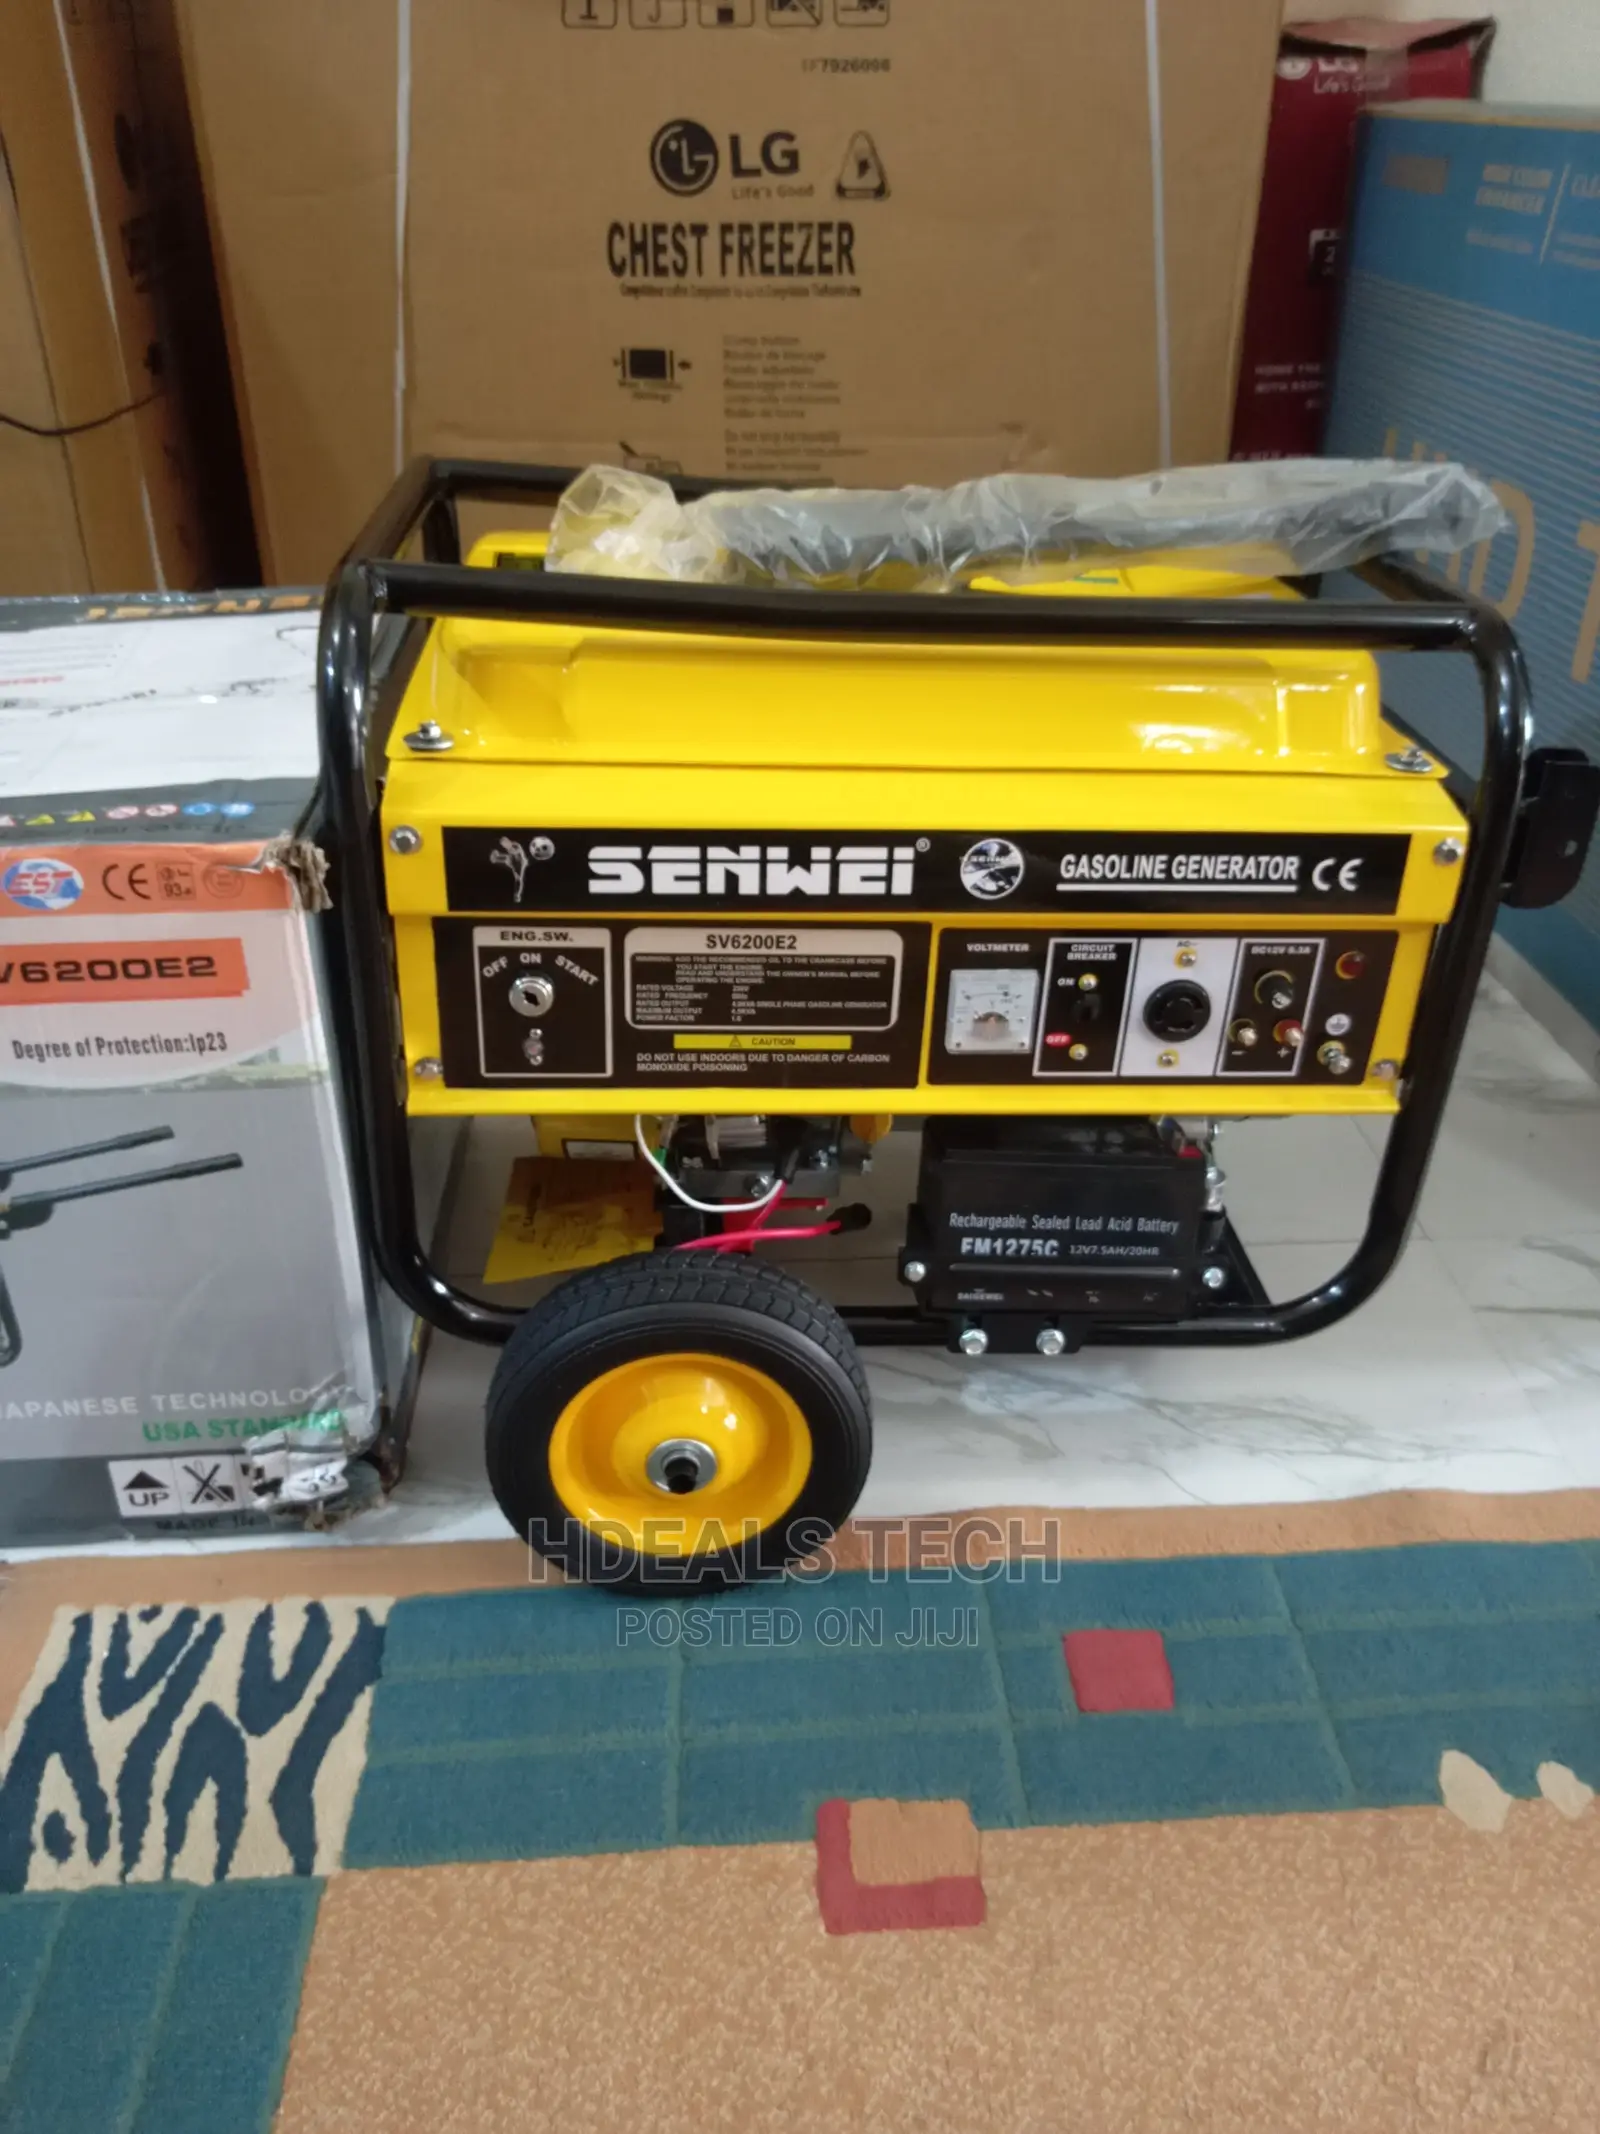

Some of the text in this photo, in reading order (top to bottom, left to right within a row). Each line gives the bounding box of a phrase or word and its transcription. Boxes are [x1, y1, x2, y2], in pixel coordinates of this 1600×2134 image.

[730, 132, 799, 178] LG
[777, 184, 814, 198] Good
[607, 222, 856, 278] CHEST FREEZER
[588, 846, 915, 895] SENWEI
[1060, 854, 1300, 881] GASOLINE GENERATOR
[8, 869, 74, 897] EST
[102, 863, 152, 900] CE
[500, 930, 574, 942] ENG.SW.
[706, 934, 798, 950] SV6200E2
[967, 943, 1030, 952] VOLTMETER
[1067, 952, 1117, 961] BREAKER
[1071, 944, 1115, 952] CIRCUIT
[483, 952, 599, 986] OFF ON START
[1057, 978, 1075, 987] ON
[12, 1039, 71, 1062] Degree
[76, 1037, 91, 1056] of
[751, 1037, 796, 1047] CAUTION
[637, 1053, 890, 1063] DO NOT USE INDOORS DUE TO DANGER OF CARBON
[637, 1062, 748, 1072] MONOXIDE POISONING
[950, 1212, 1180, 1234] Rechargeable Sealed Lead Acid Battery
[961, 1237, 1060, 1257] FM1275C
[0, 1397, 139, 1420] APANESE
[143, 1420, 201, 1443] USA
[128, 1492, 170, 1507] UP
